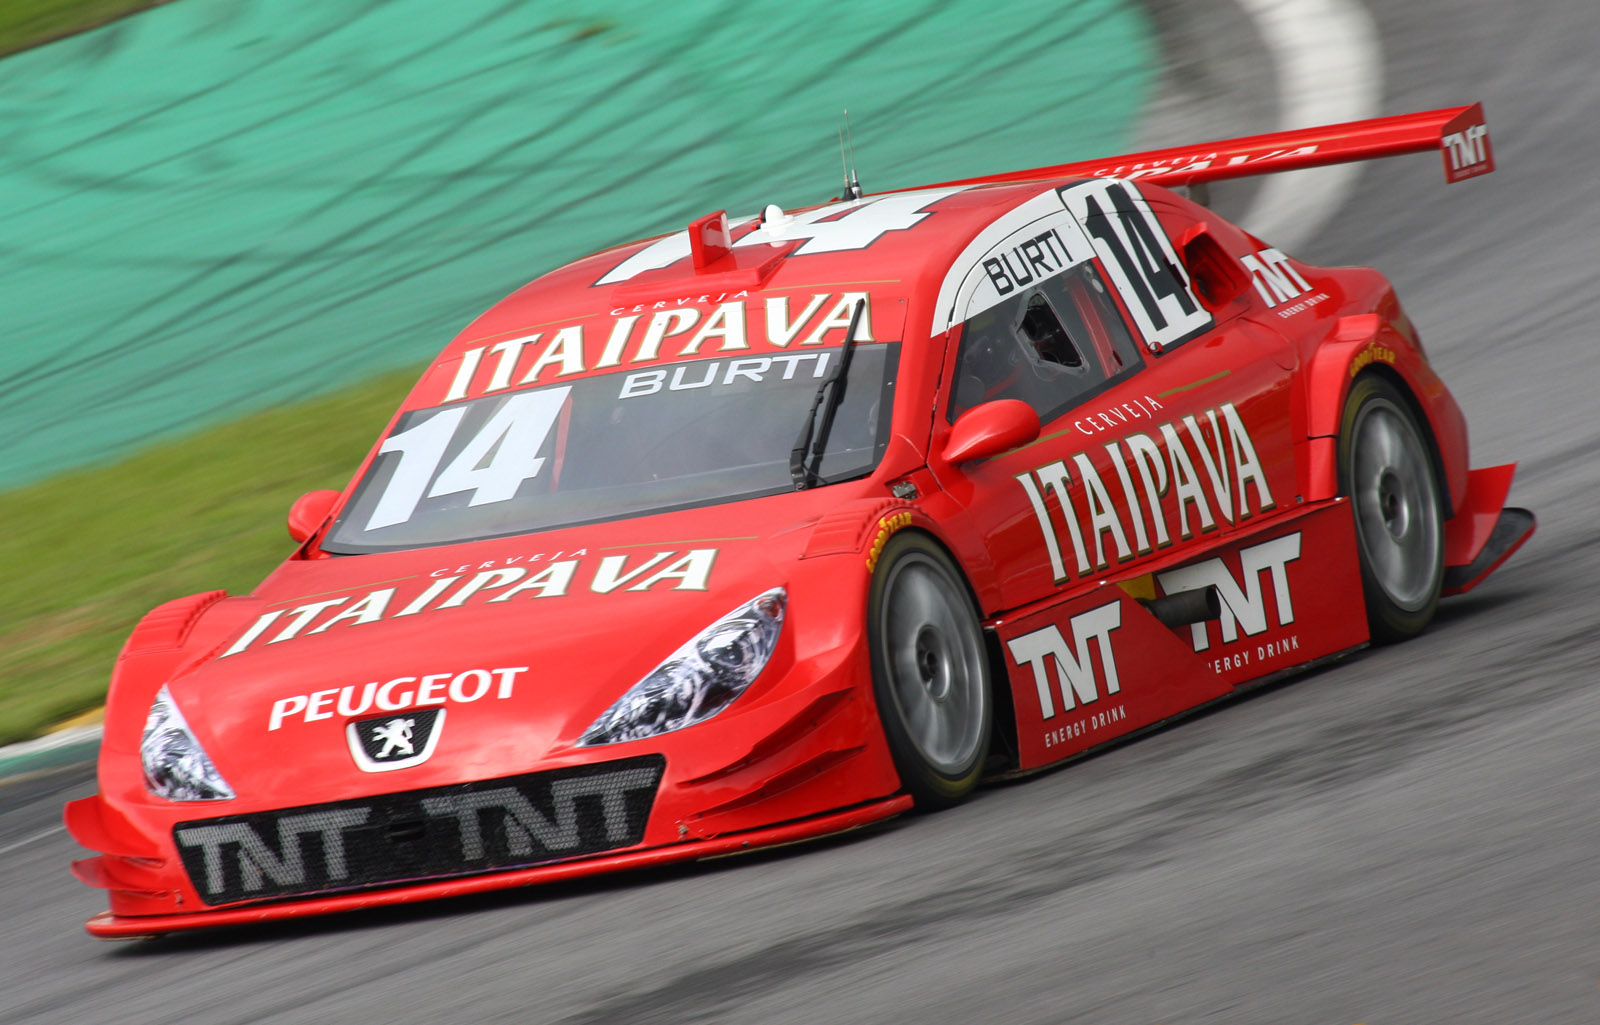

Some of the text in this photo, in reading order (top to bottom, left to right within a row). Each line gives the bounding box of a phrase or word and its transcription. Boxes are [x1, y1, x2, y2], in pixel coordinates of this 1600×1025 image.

[1093, 152, 1218, 176] CERVEJA
[1442, 123, 1487, 170] TNT
[982, 228, 1074, 296] BURTI
[1085, 183, 1199, 332] 14
[1240, 247, 1314, 309] TNT
[609, 289, 750, 316] CERVEJA
[441, 291, 876, 404] ITAIPAVA
[618, 352, 831, 400] BURTI
[1073, 395, 1163, 435] CERVEJA
[364, 385, 573, 532] 14
[1012, 400, 1277, 587] ITAIPAVA
[430, 547, 588, 577] CERVEJA
[1156, 531, 1302, 653] TNT
[217, 548, 718, 660] ITAIPAVA
[1006, 598, 1122, 721] TNT
[1207, 635, 1300, 674] ERGY DRINK
[267, 666, 529, 731] PEUGEOT
[1044, 704, 1127, 748] ENERGY DRINK
[421, 765, 659, 862] TNT
[178, 806, 373, 896] TNT
